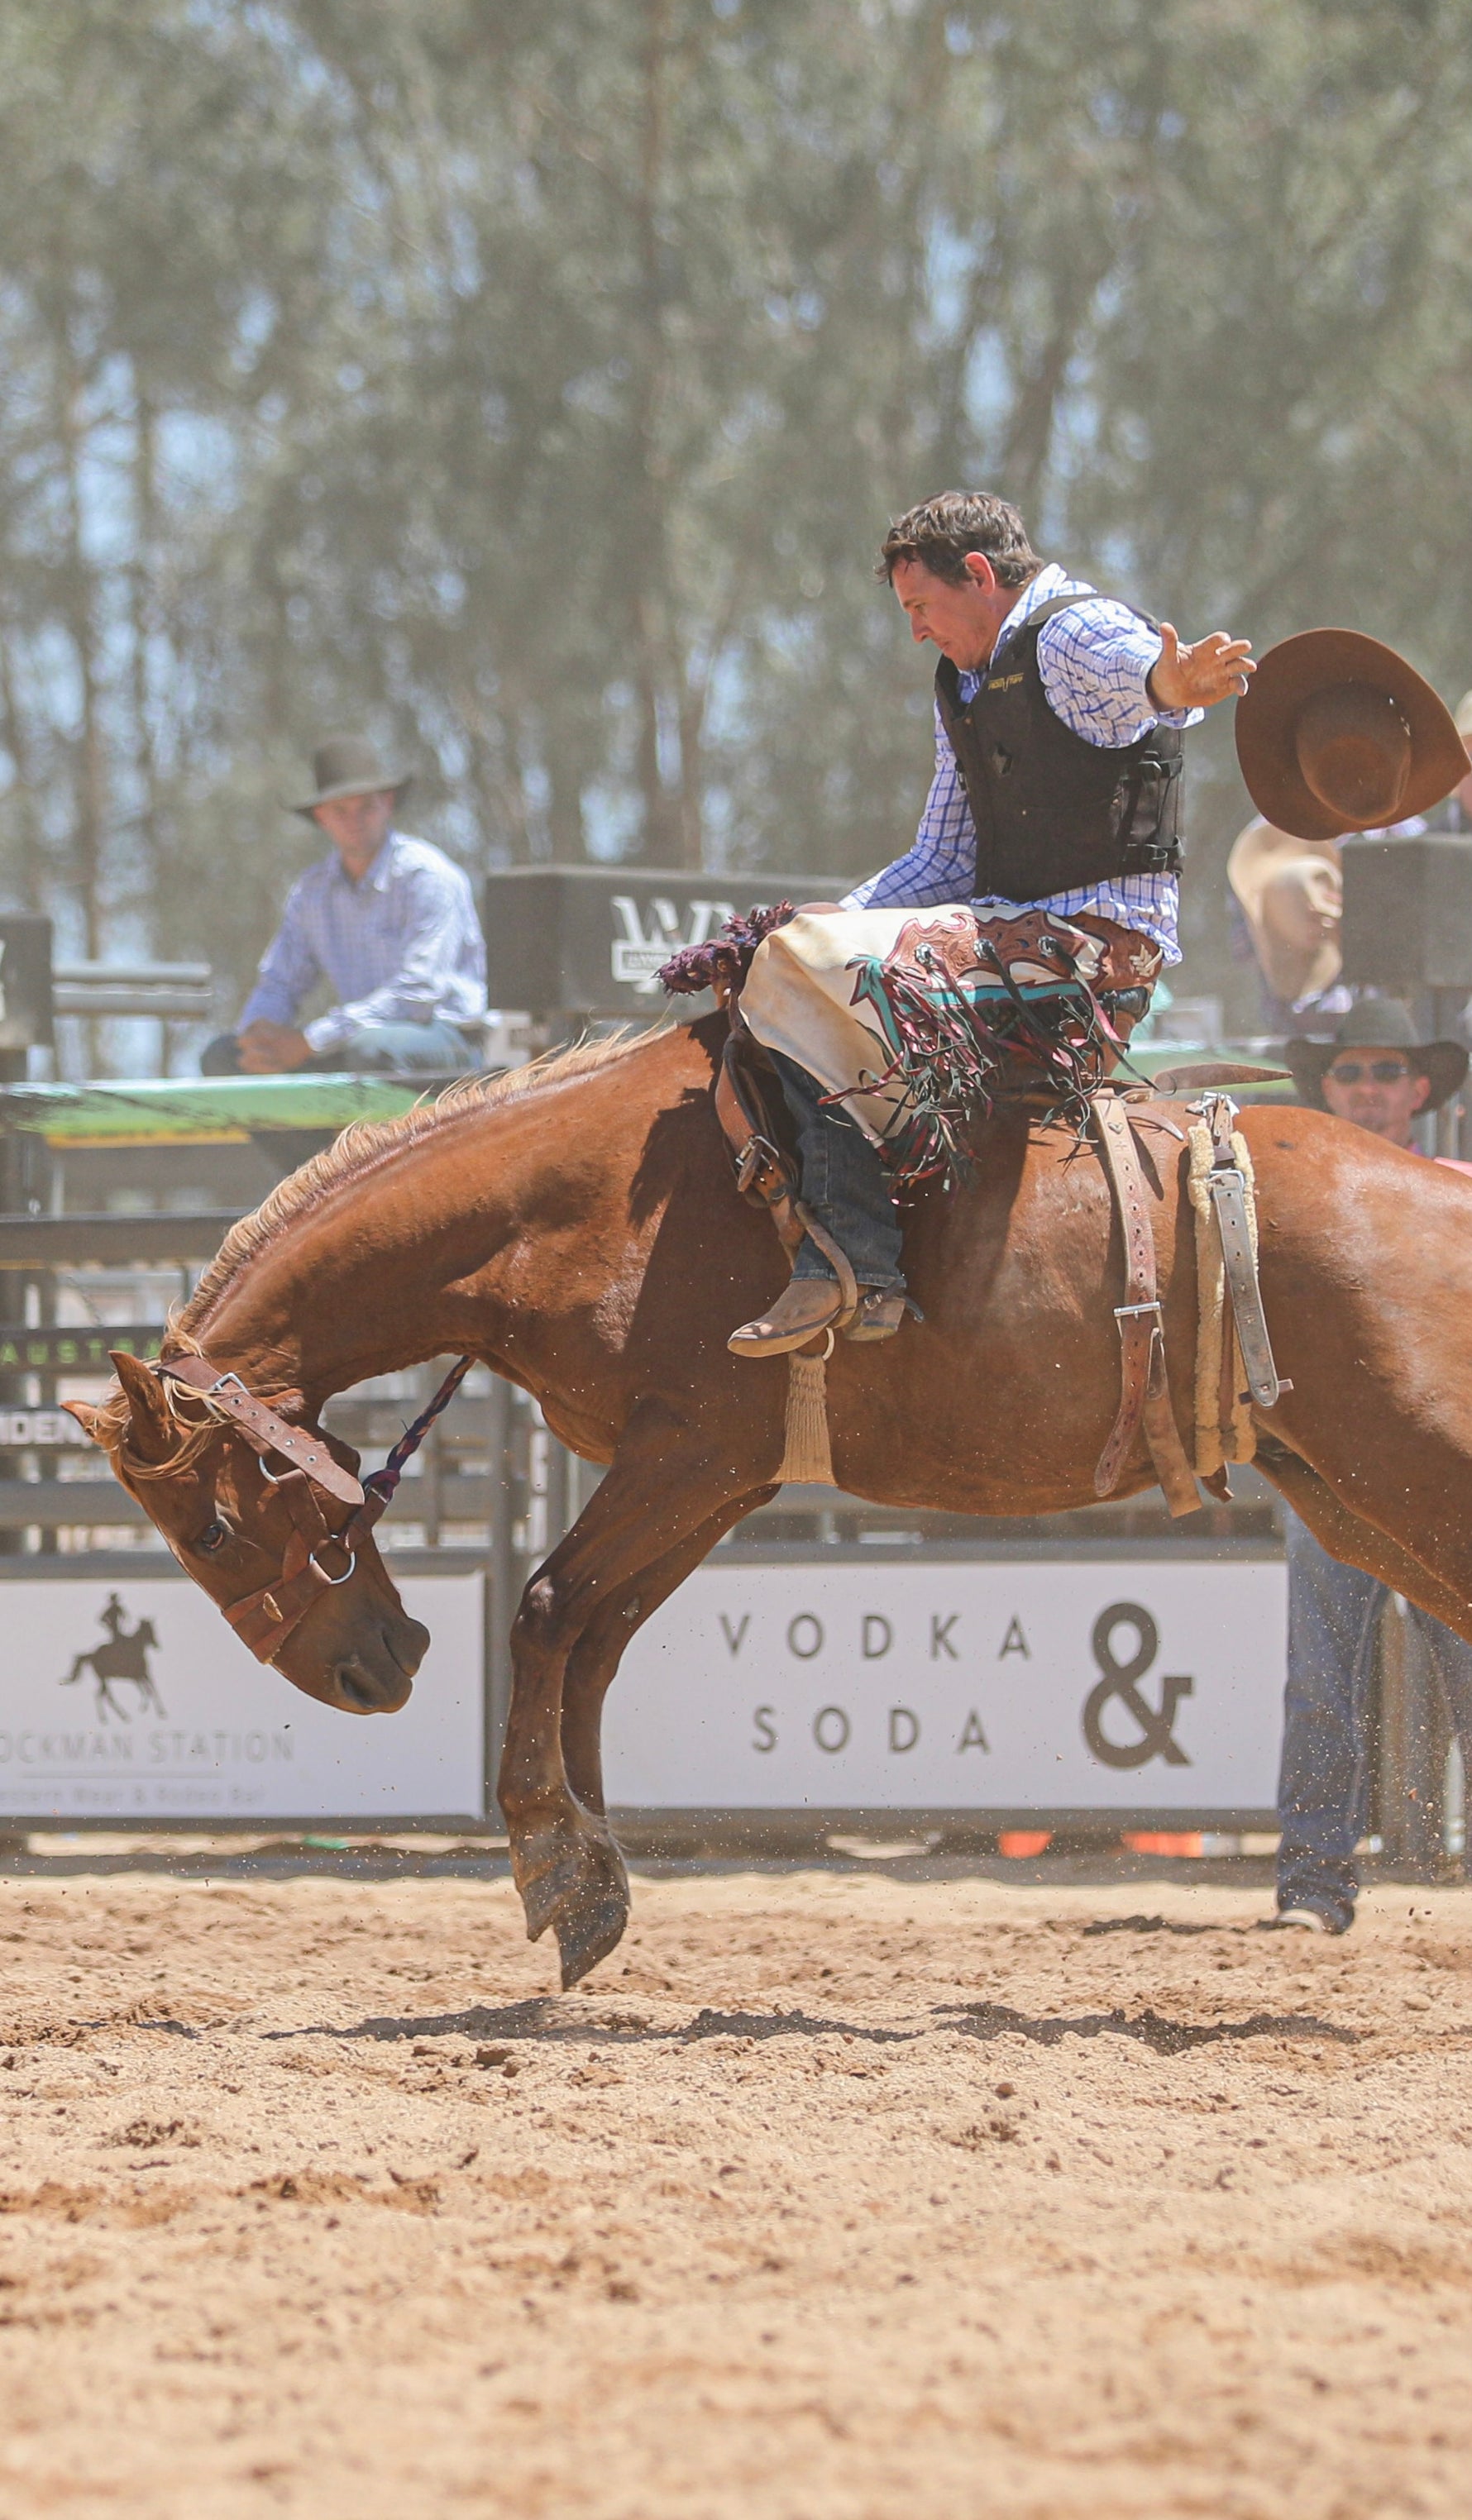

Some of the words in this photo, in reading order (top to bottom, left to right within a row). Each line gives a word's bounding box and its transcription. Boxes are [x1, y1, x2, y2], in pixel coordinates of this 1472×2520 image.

[719, 1612, 1032, 1662] VODKA
[1080, 1601, 1195, 1771] &
[147, 1730, 296, 1764] STATION
[753, 1706, 992, 1755] SODA
